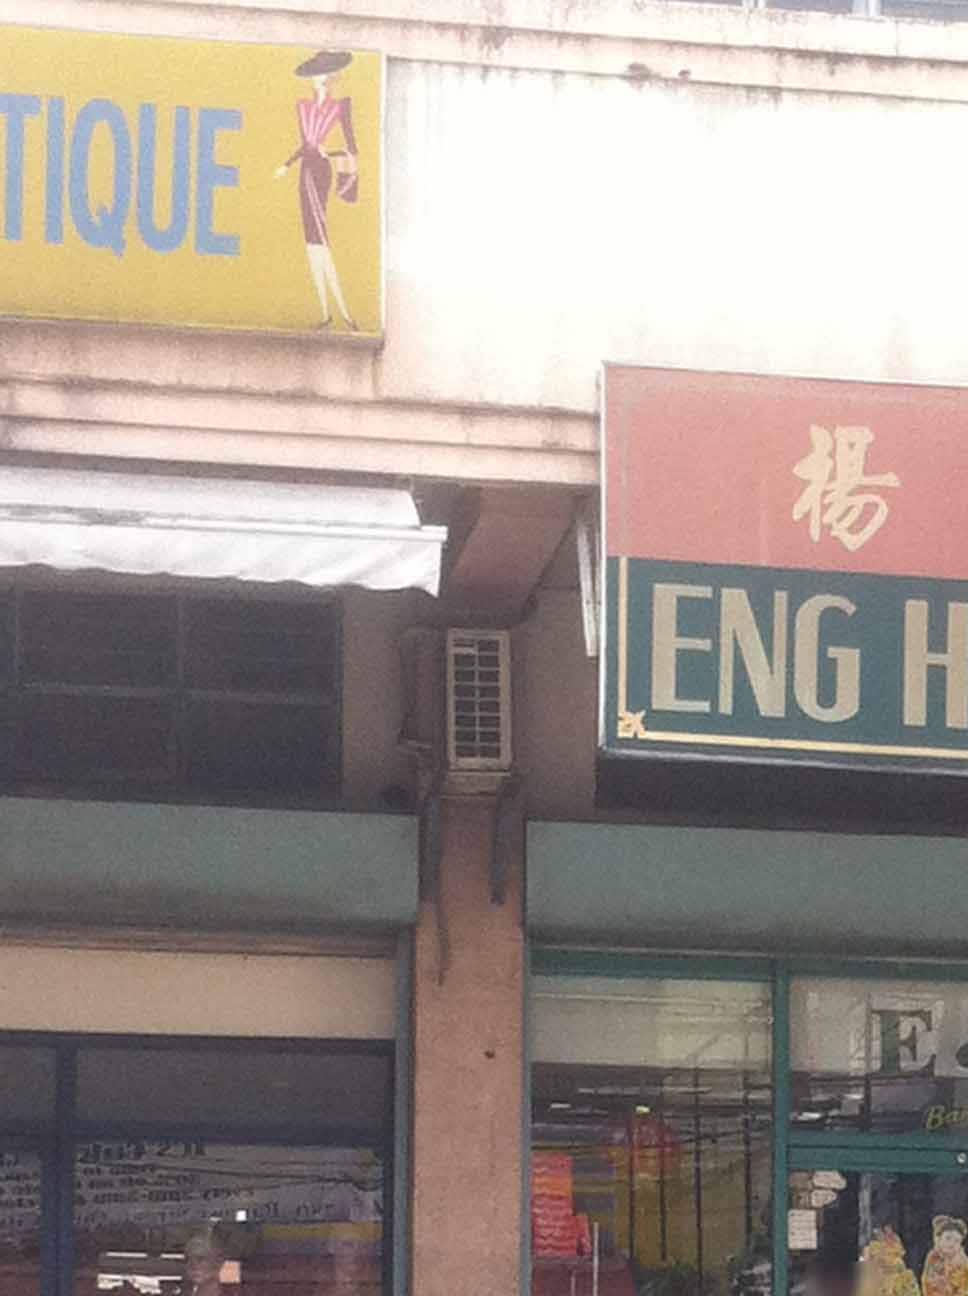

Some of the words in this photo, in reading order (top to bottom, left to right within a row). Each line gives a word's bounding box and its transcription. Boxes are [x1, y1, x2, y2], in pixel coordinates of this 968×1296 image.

[0, 93, 242, 257] TIQUE
[650, 582, 862, 723] ENG
[869, 1007, 937, 1079] E
